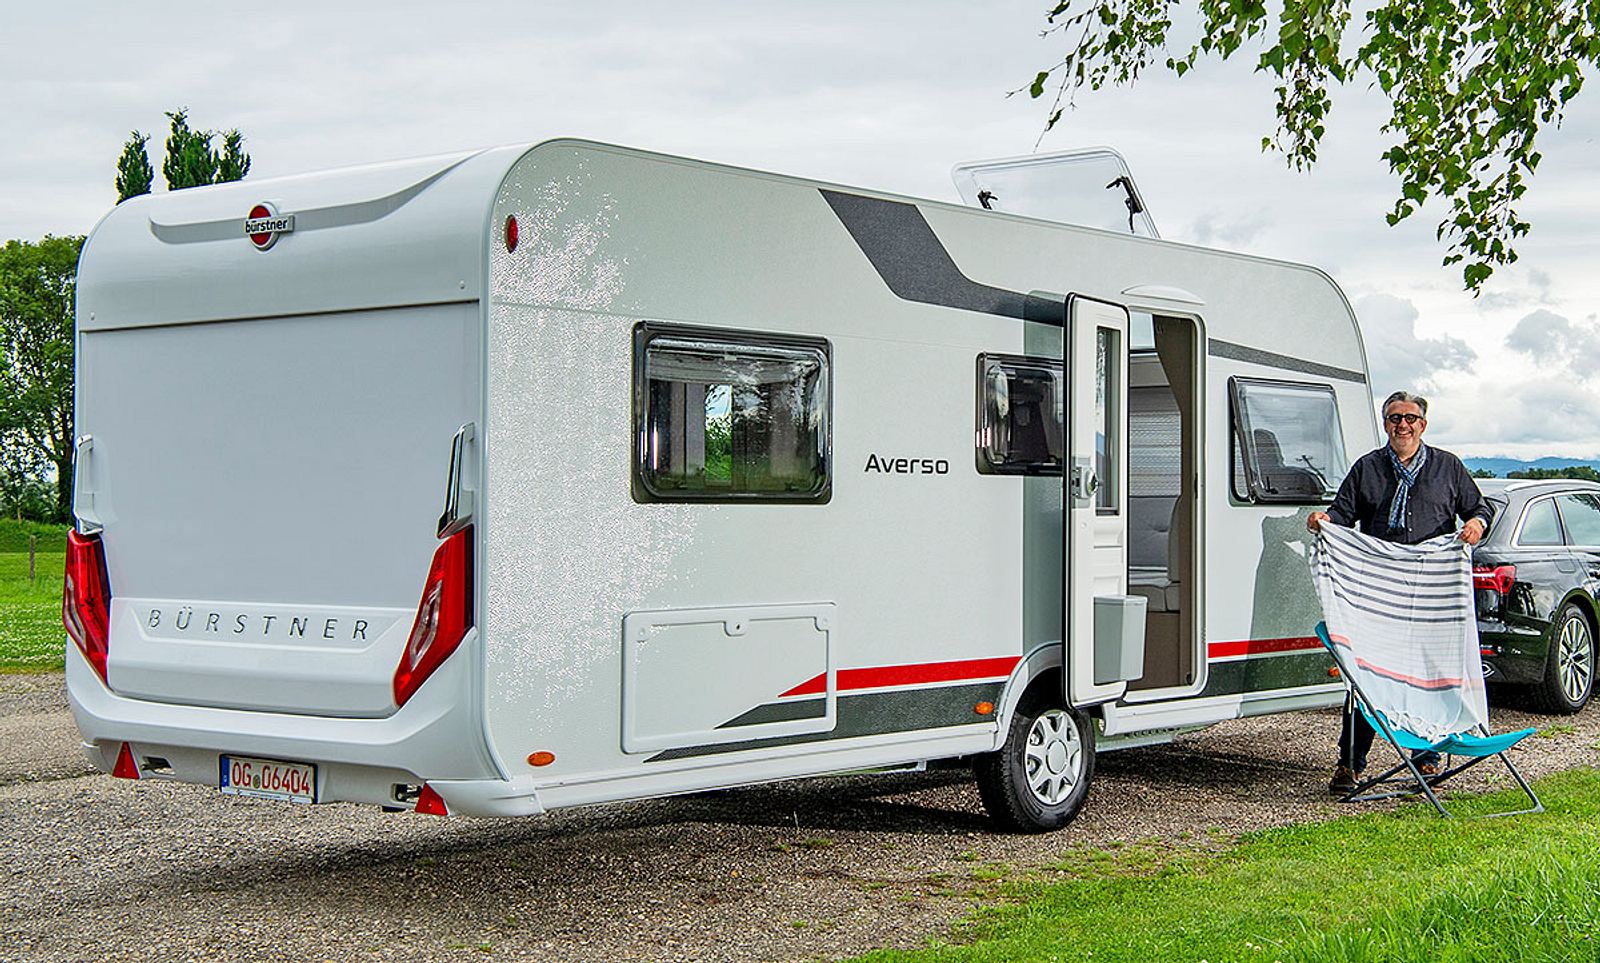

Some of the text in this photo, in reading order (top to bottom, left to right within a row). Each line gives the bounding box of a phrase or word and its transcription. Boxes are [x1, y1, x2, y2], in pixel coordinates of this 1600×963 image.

[245, 219, 288, 233] bürstner
[864, 453, 949, 475] Averso
[148, 606, 369, 641] BÜRSTNER
[231, 761, 311, 795] OG 06404
